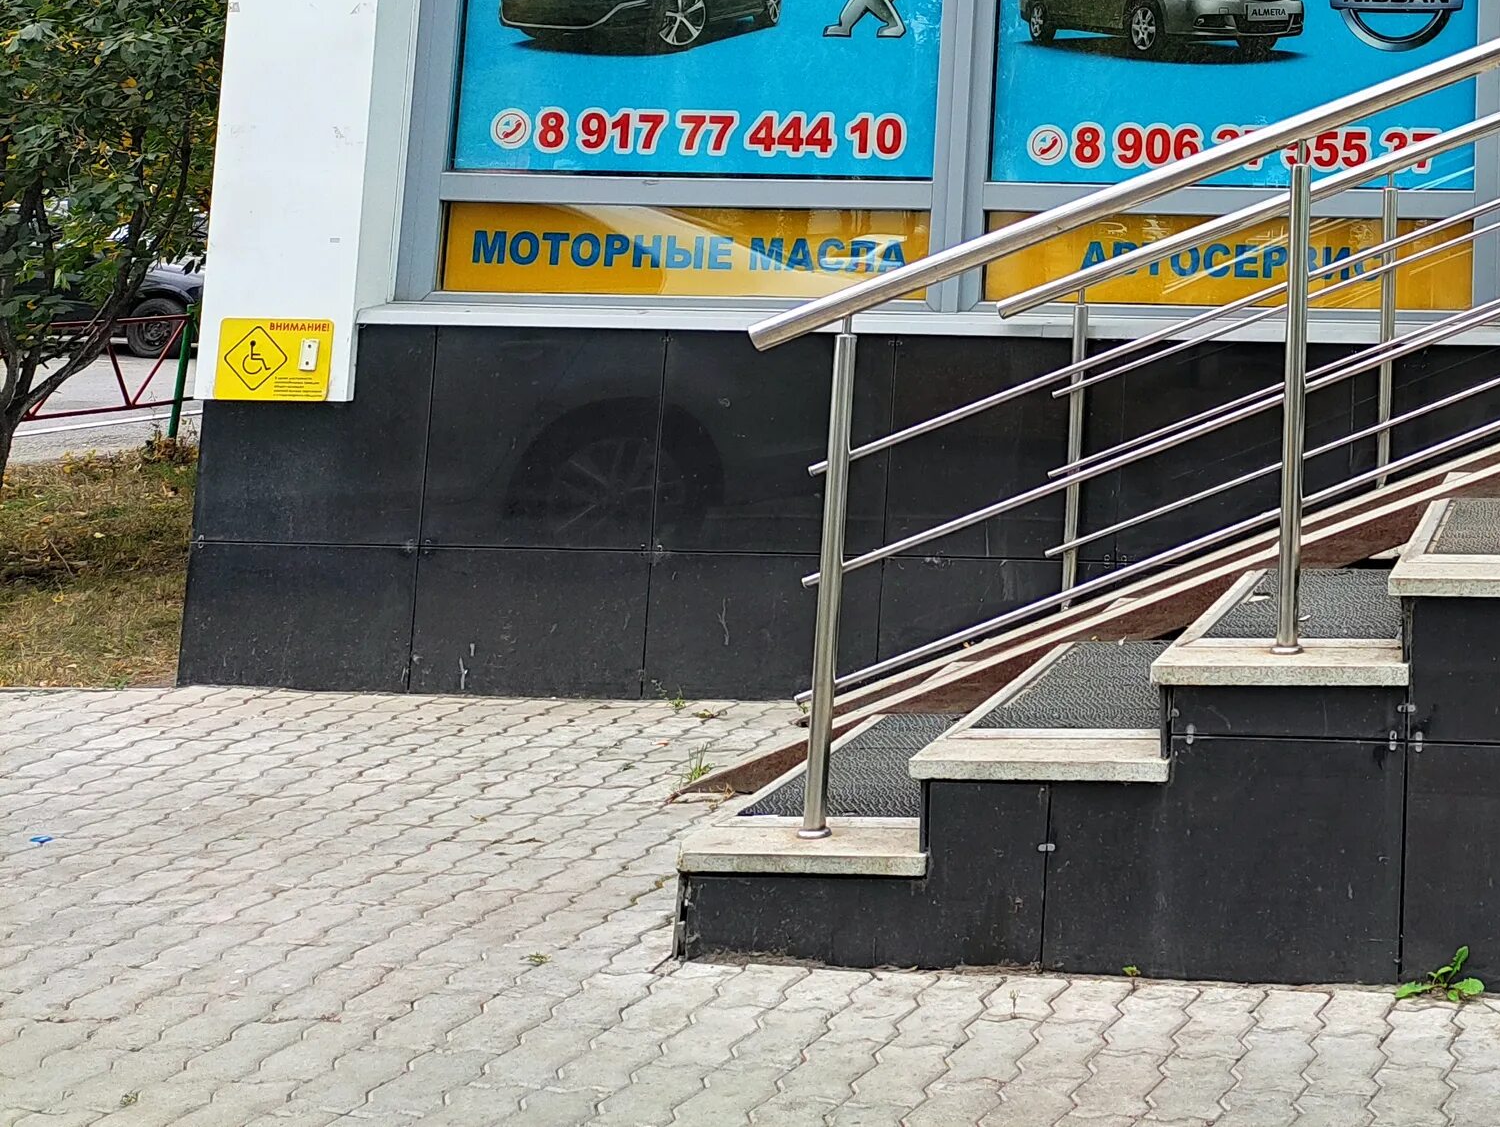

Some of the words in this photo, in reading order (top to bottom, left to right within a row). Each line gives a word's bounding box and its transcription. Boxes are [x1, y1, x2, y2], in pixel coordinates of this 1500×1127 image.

[1251, 7, 1287, 18] ALMERA
[535, 112, 564, 150] 8
[581, 112, 664, 151] 917
[680, 115, 735, 152] 77
[749, 117, 832, 153] 444
[850, 118, 903, 154] 10
[1074, 126, 1101, 165] 8
[1117, 128, 1199, 165] 906
[471, 230, 734, 269] МОТОРНЫЕ
[749, 237, 907, 273] МАСЛА
[269, 322, 330, 332] ВНИМАНИЕ!
